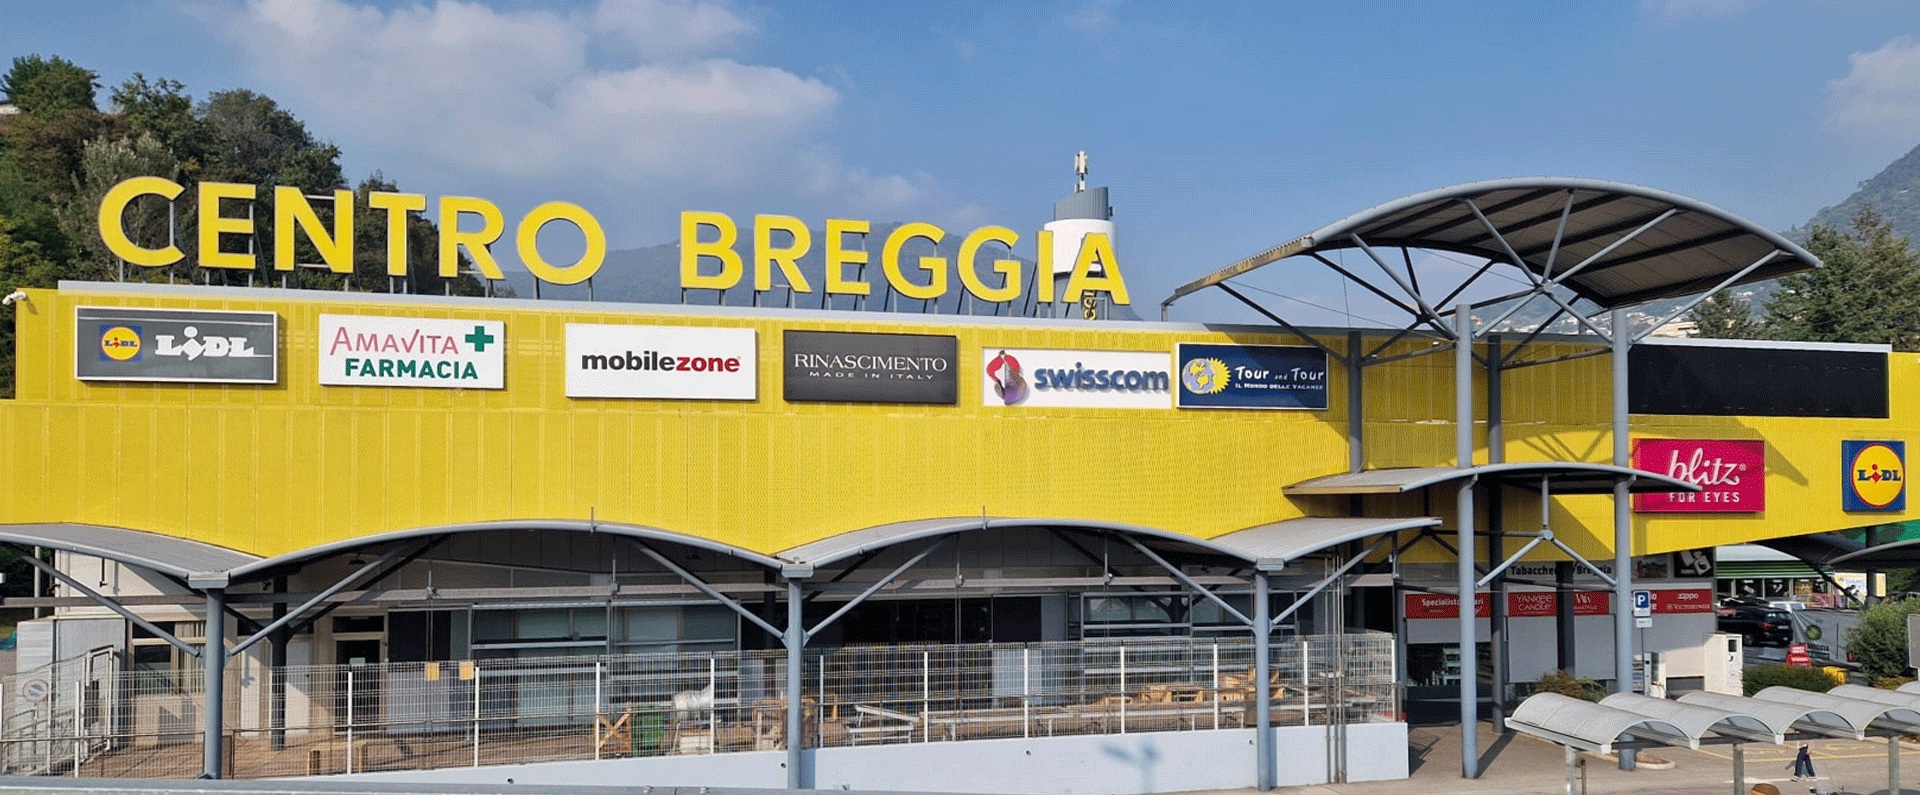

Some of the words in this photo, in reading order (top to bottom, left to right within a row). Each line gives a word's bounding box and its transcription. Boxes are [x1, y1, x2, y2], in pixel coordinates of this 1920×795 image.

[99, 176, 607, 285] CENTRO
[680, 211, 1131, 305] BREGGIA
[345, 357, 479, 380] FARMACIA
[581, 350, 741, 372] mobilezone
[794, 353, 948, 372] RINASCIMENTO
[809, 371, 855, 379] MADE
[1034, 361, 1170, 391] swisscom
[1234, 366, 1270, 380] Tour
[1290, 367, 1325, 381] Tour
[1669, 492, 1696, 503] FOR
[1704, 491, 1740, 503] EYES
[1576, 564, 1612, 576] Breia
[1637, 594, 1646, 606] P
